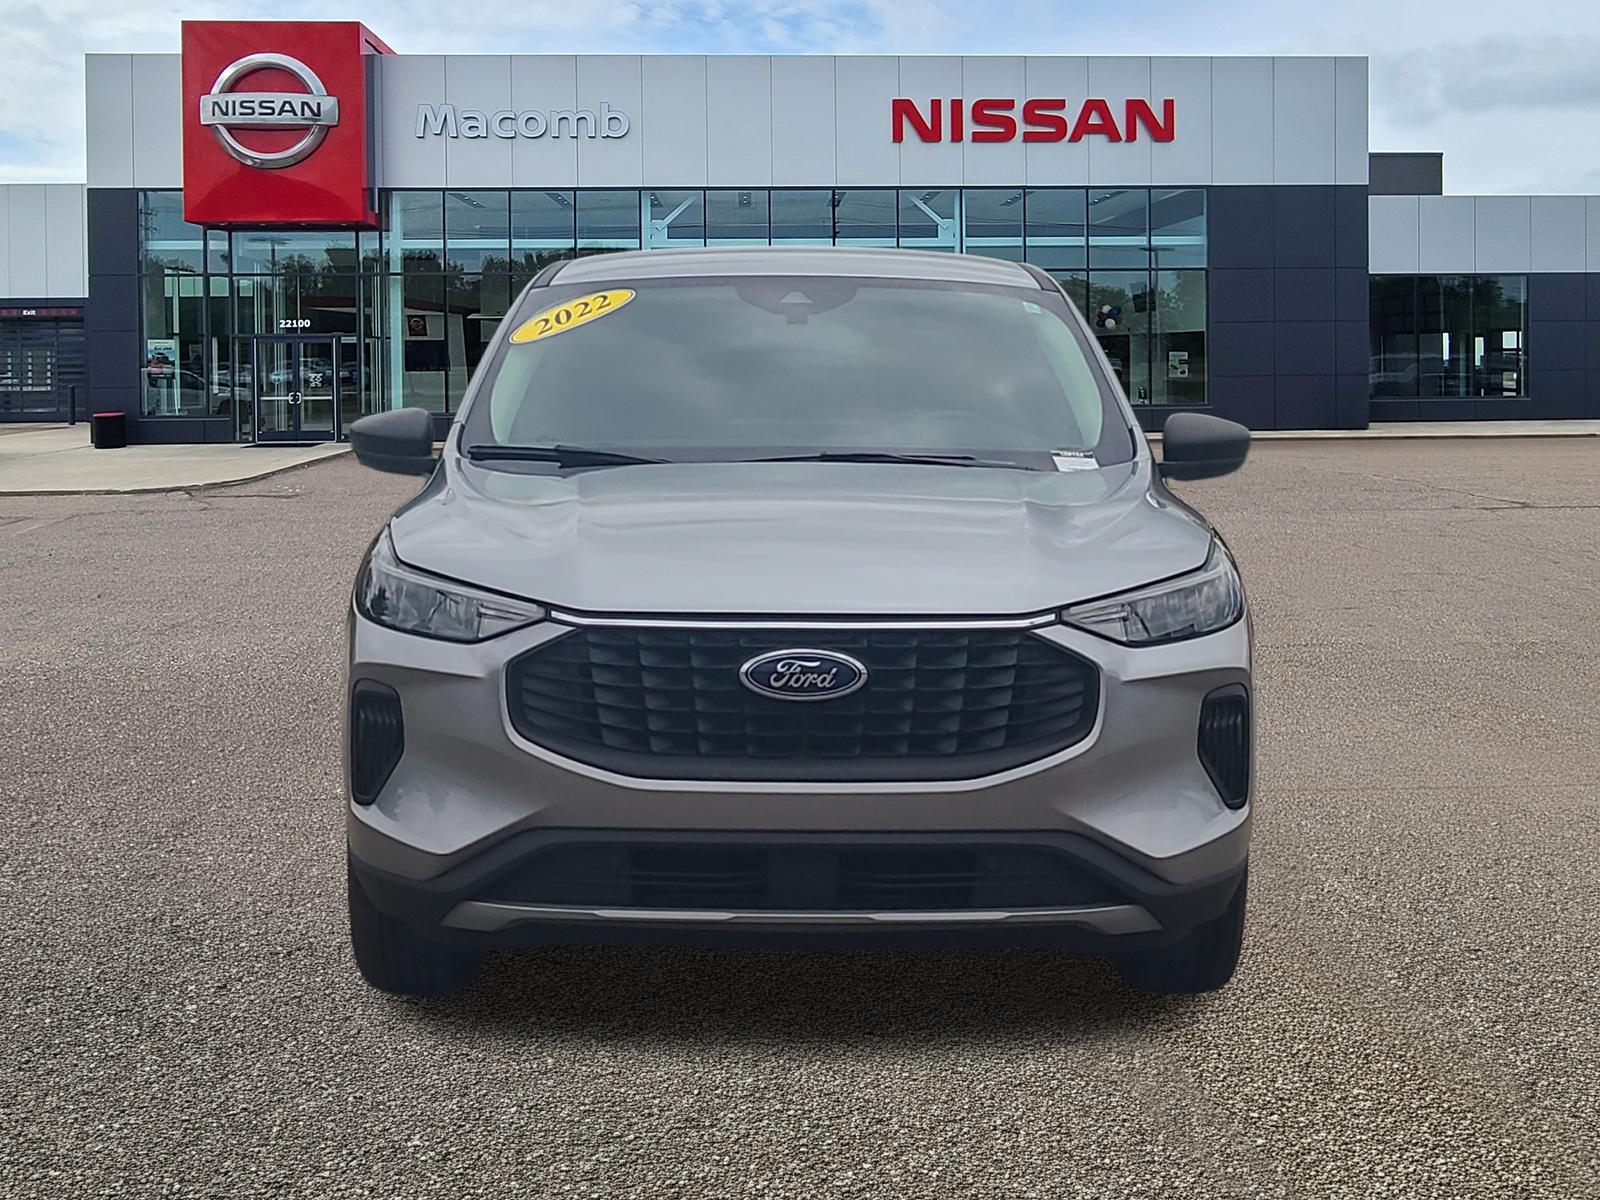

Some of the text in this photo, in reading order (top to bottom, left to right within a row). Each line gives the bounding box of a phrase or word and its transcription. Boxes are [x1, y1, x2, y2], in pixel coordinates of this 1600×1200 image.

[211, 100, 322, 118] NISSAN
[415, 102, 631, 139] Macomb
[891, 98, 1175, 143] NISSAN
[279, 319, 311, 328] 22100
[534, 294, 612, 336] 2022
[769, 659, 838, 688] Ford
